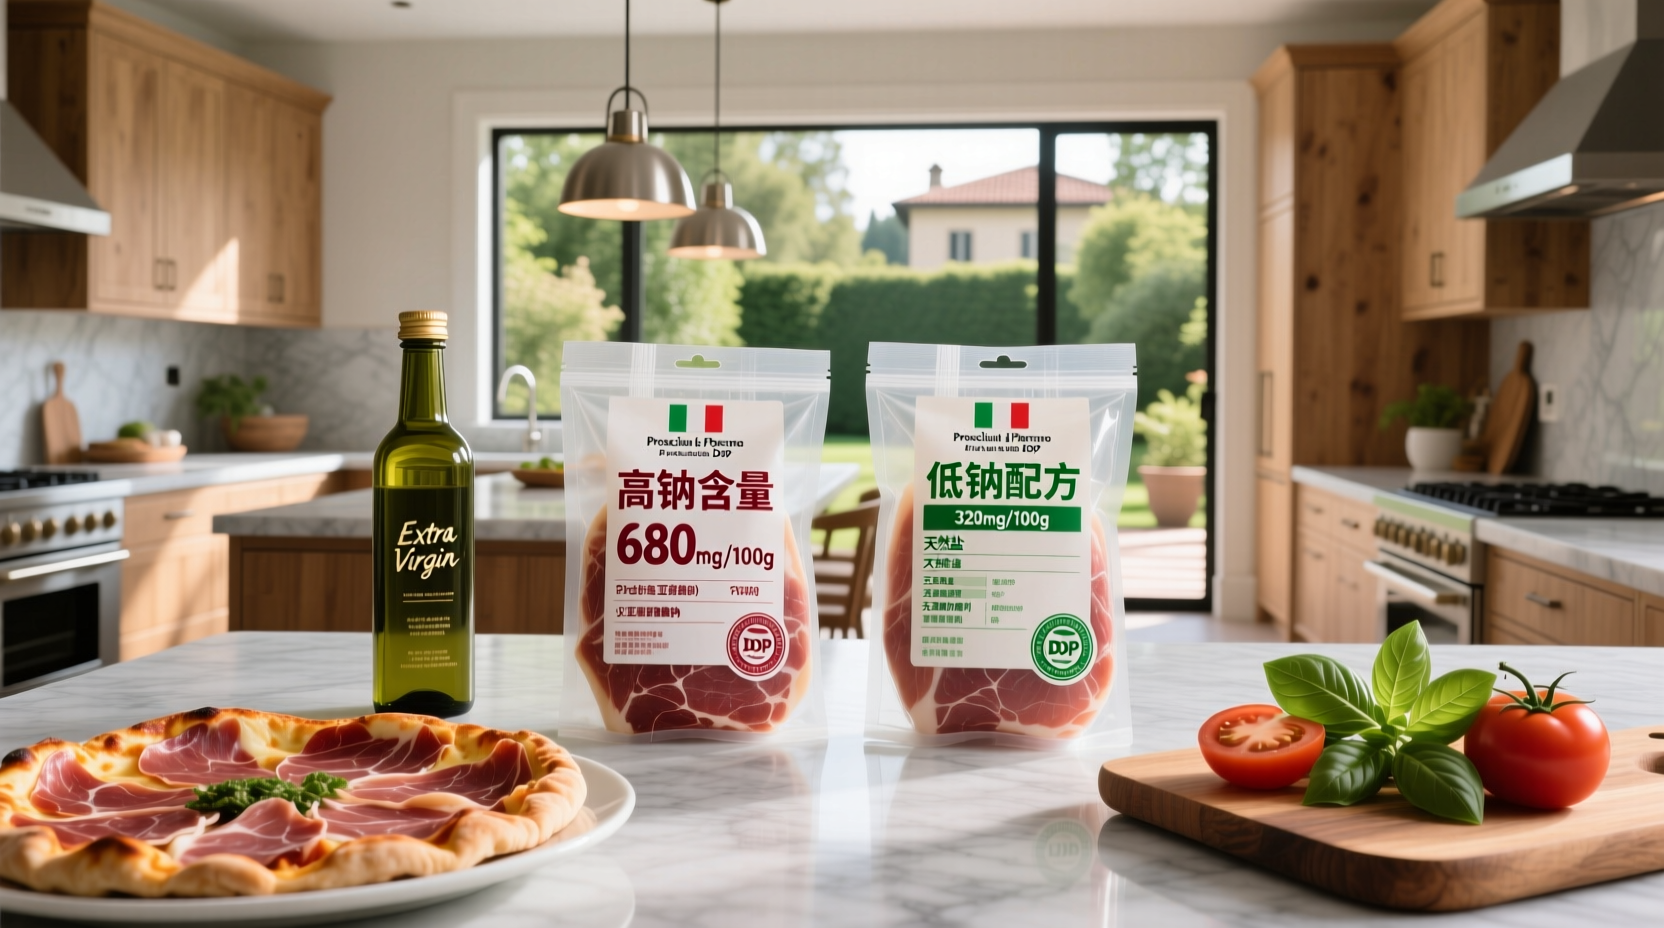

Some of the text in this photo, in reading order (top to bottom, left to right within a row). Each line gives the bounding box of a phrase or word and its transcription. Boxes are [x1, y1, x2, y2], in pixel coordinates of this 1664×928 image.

[618, 469, 774, 511] 高钠含量
[926, 461, 1081, 501] 低钠配方
[397, 520, 458, 546] Extra
[954, 509, 1050, 531] 320mg/100g
[394, 547, 460, 580] Virgin
[617, 522, 774, 570] 680mg/100g
